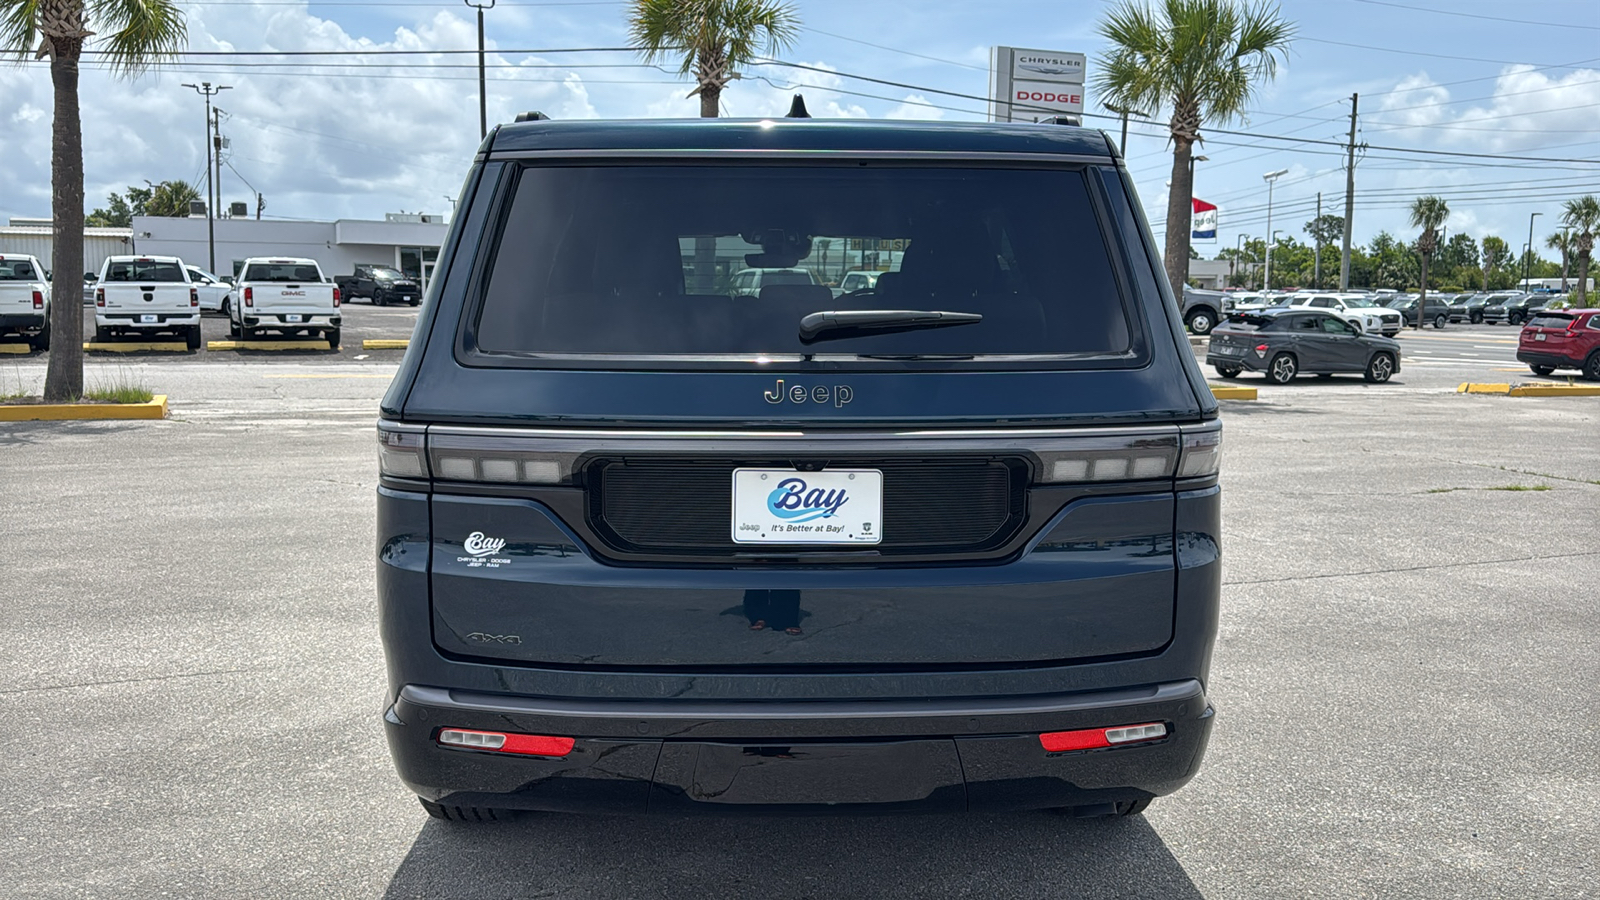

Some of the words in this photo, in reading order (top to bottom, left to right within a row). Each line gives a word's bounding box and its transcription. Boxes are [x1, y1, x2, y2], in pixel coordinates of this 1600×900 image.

[1020, 56, 1081, 67] CHRYSLER
[1017, 91, 1081, 104] DODGE
[764, 380, 853, 408] Jeep
[773, 477, 849, 518] Bay
[739, 522, 761, 533] Jeep
[771, 524, 784, 532] It's
[786, 524, 813, 533] Better
[814, 525, 824, 533] at
[825, 525, 845, 534] Bay!
[466, 531, 507, 556] Bay
